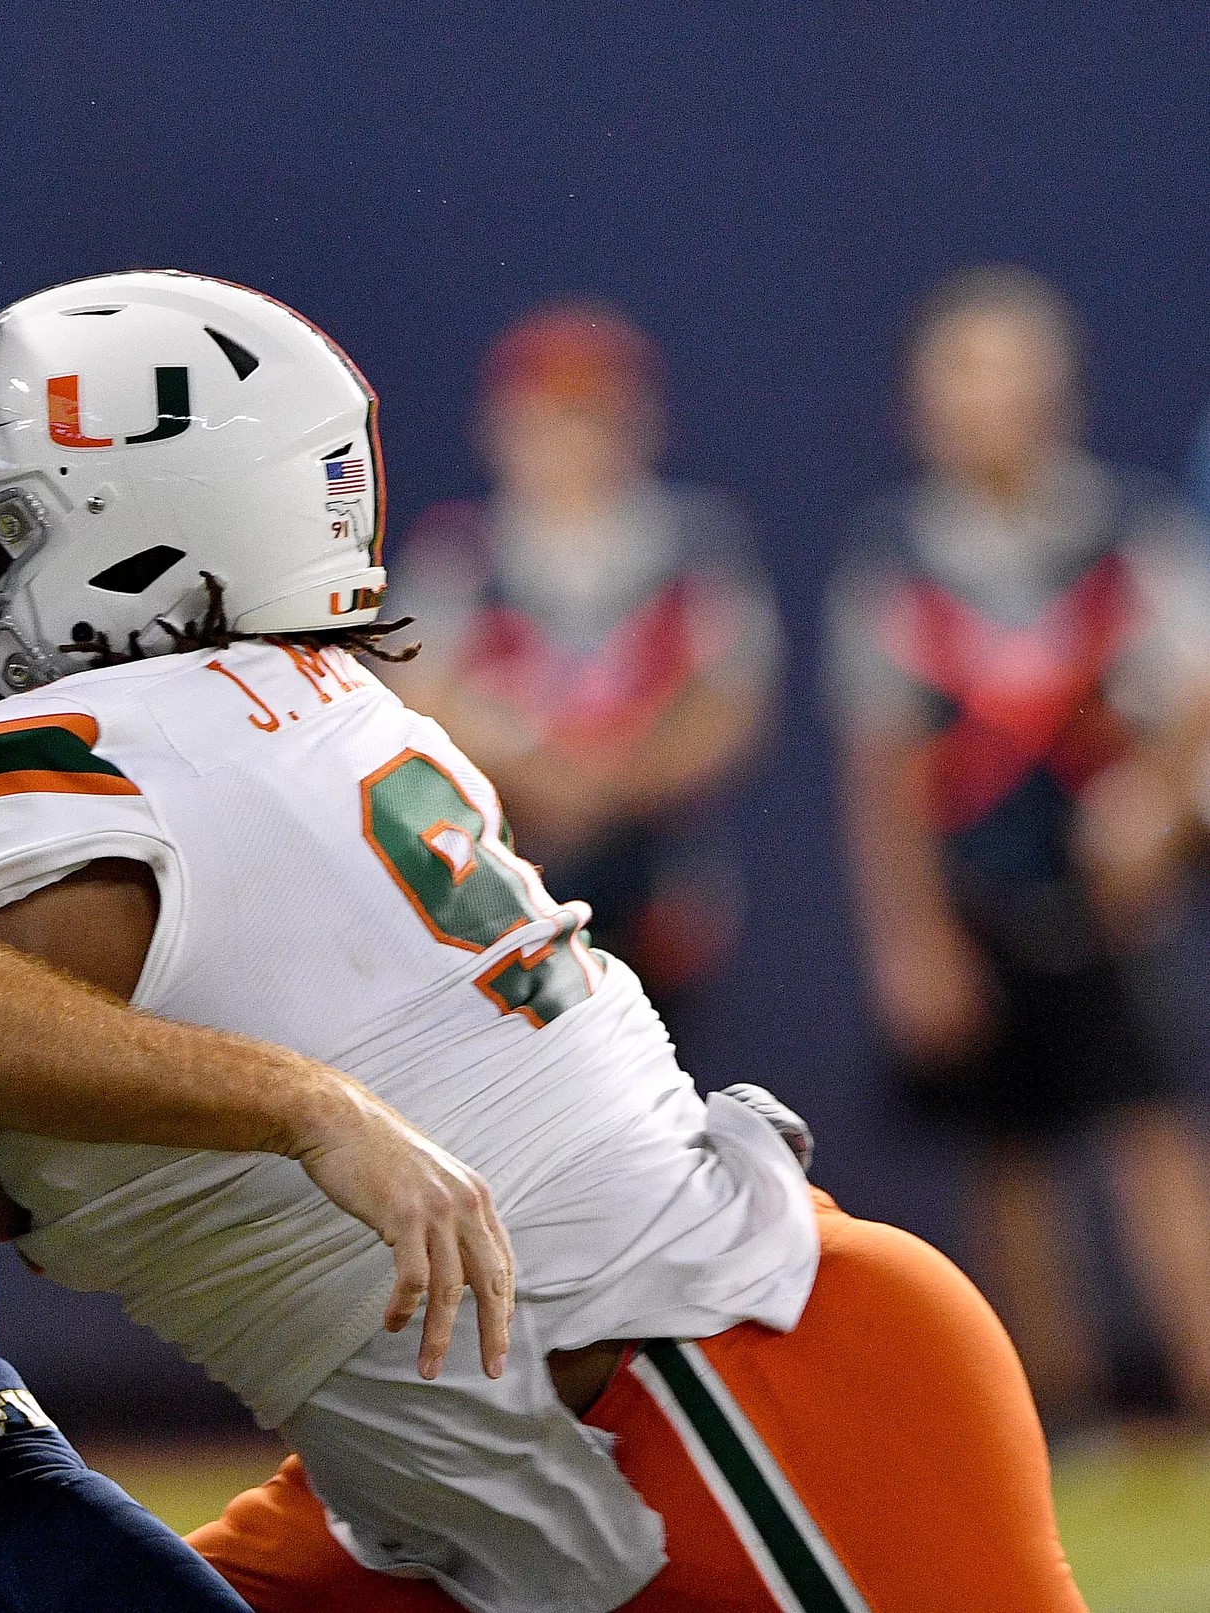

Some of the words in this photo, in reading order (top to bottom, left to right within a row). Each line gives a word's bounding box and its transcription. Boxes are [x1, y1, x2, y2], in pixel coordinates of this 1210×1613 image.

[47, 365, 191, 450] U
[331, 519, 349, 540] 91
[205, 659, 300, 733] J.
[262, 634, 367, 703] M
[359, 746, 600, 1030] 9
